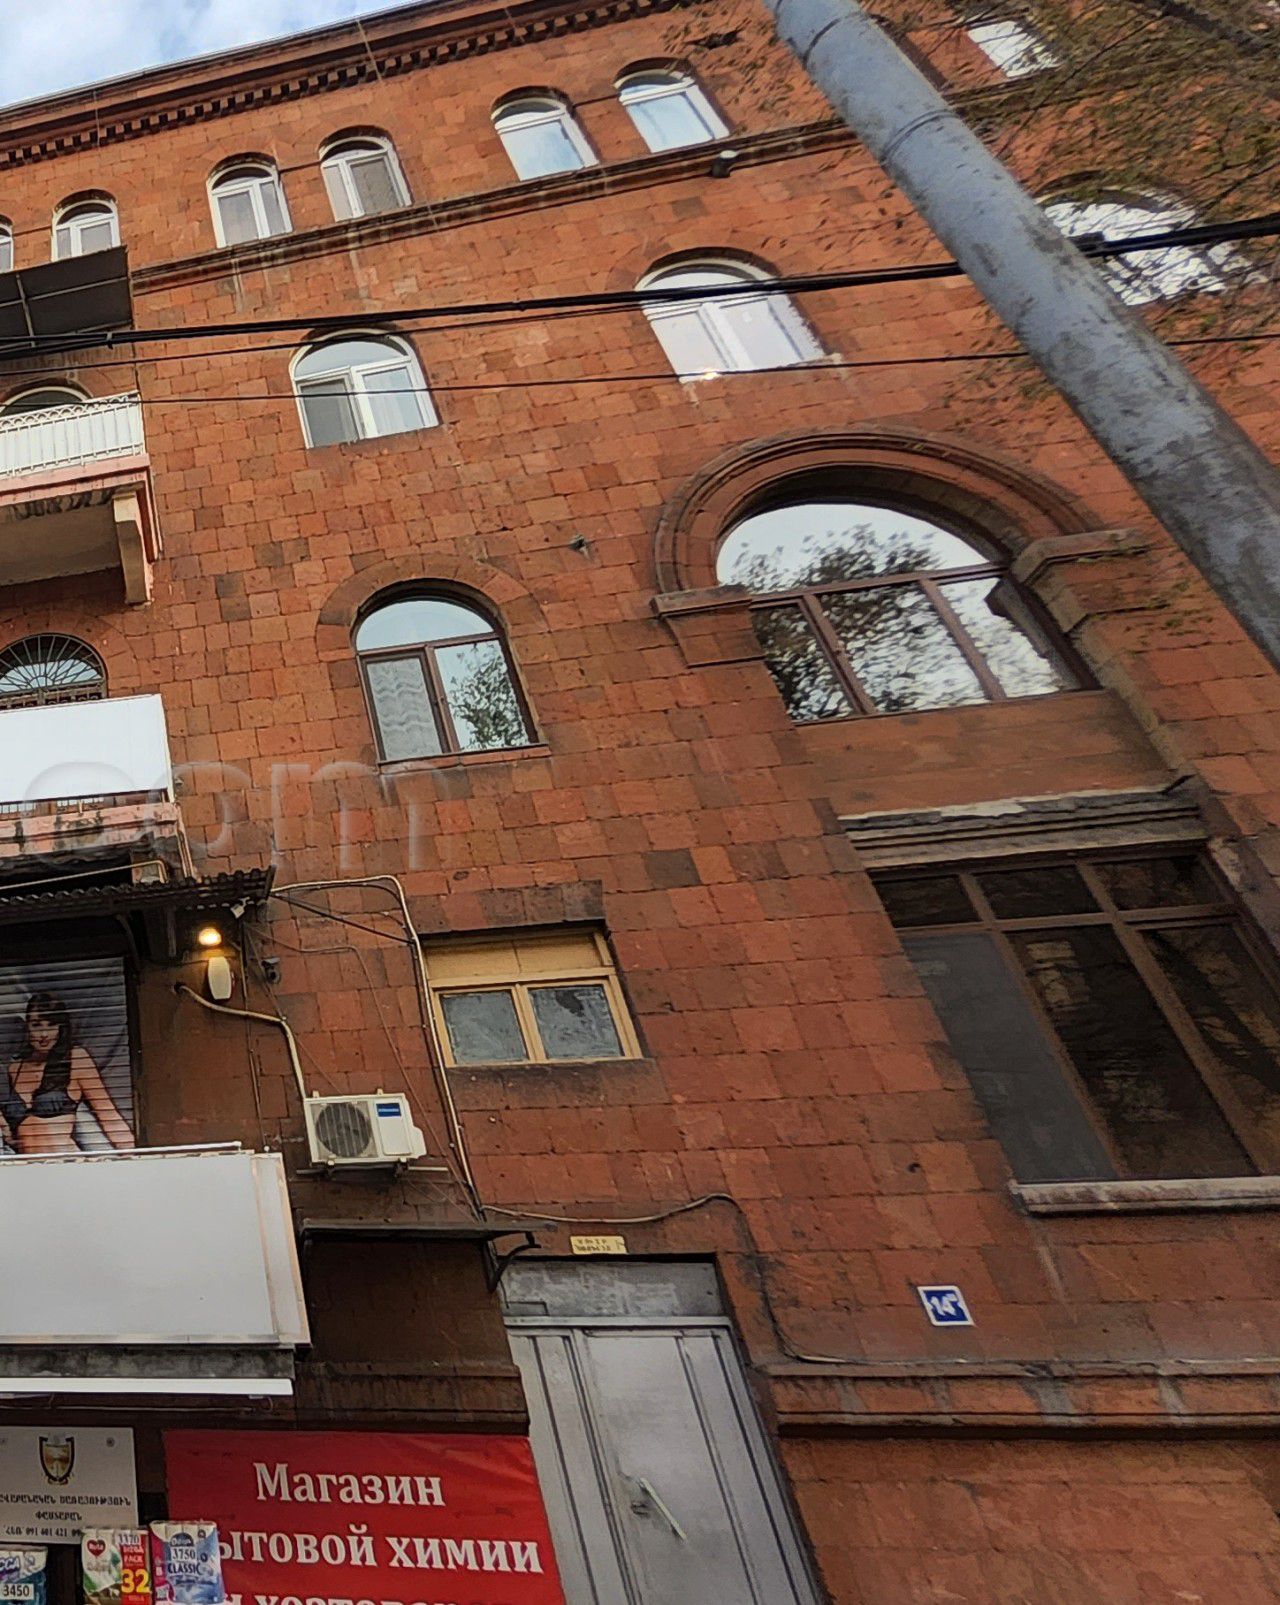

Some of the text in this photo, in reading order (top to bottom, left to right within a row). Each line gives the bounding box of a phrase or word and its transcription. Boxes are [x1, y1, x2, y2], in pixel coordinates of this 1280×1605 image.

[252, 1460, 446, 1507] Магазин
[218, 1523, 544, 1574] ытовой химии
[121, 1568, 151, 1594] 32
[167, 1561, 202, 1576] CLASSIC
[2, 1584, 30, 1597] 3450
